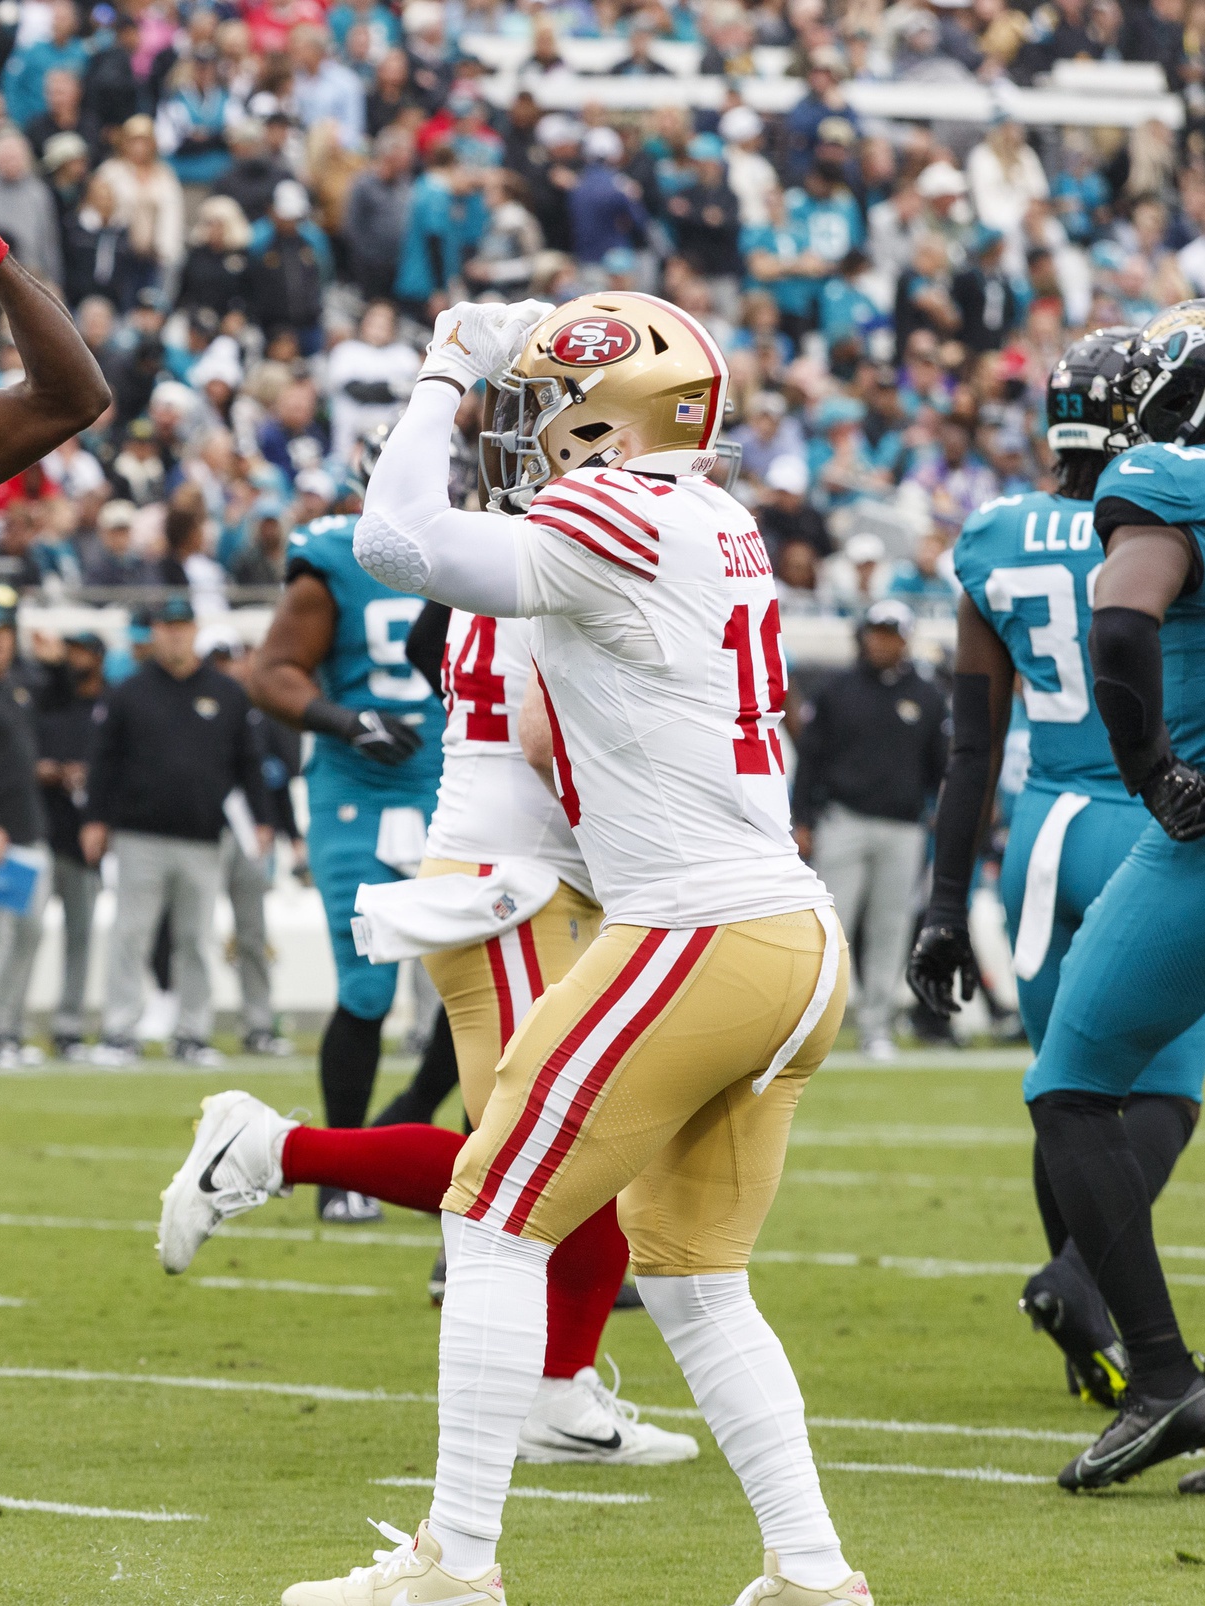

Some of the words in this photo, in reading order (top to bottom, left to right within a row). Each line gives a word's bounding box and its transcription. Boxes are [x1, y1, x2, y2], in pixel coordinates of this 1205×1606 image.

[568, 321, 623, 361] SF
[1056, 393, 1083, 418] 33
[1024, 510, 1105, 552] LLO
[985, 563, 1106, 723] 3
[441, 607, 509, 742] 4
